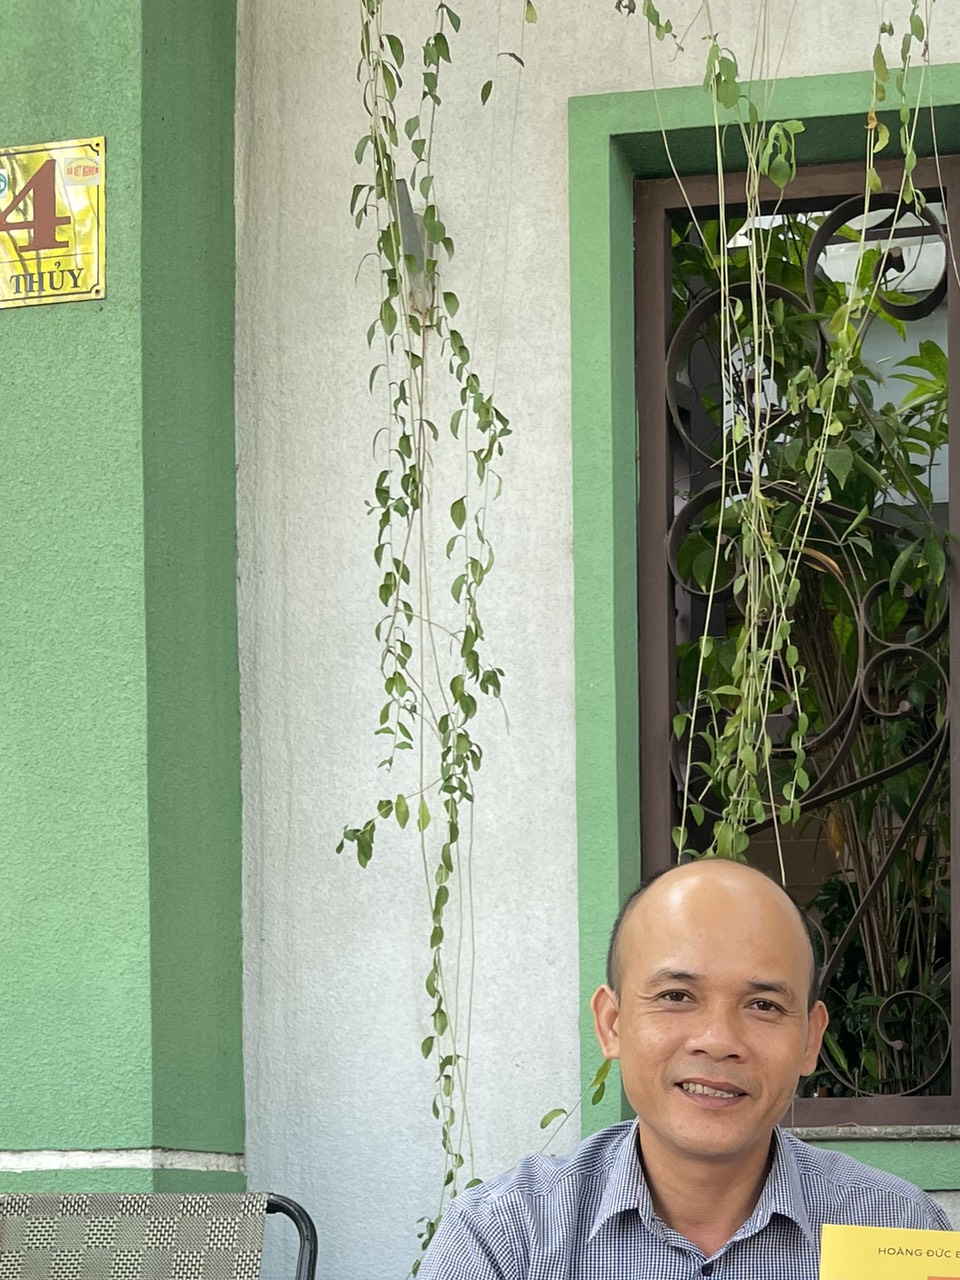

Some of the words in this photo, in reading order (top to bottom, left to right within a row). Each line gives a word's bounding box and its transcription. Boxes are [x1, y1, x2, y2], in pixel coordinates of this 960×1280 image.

[0, 158, 71, 253] 4
[10, 261, 84, 294] THỦY
[878, 1246, 922, 1257] HOÀNG
[926, 1248, 951, 1259] ĐỨC
